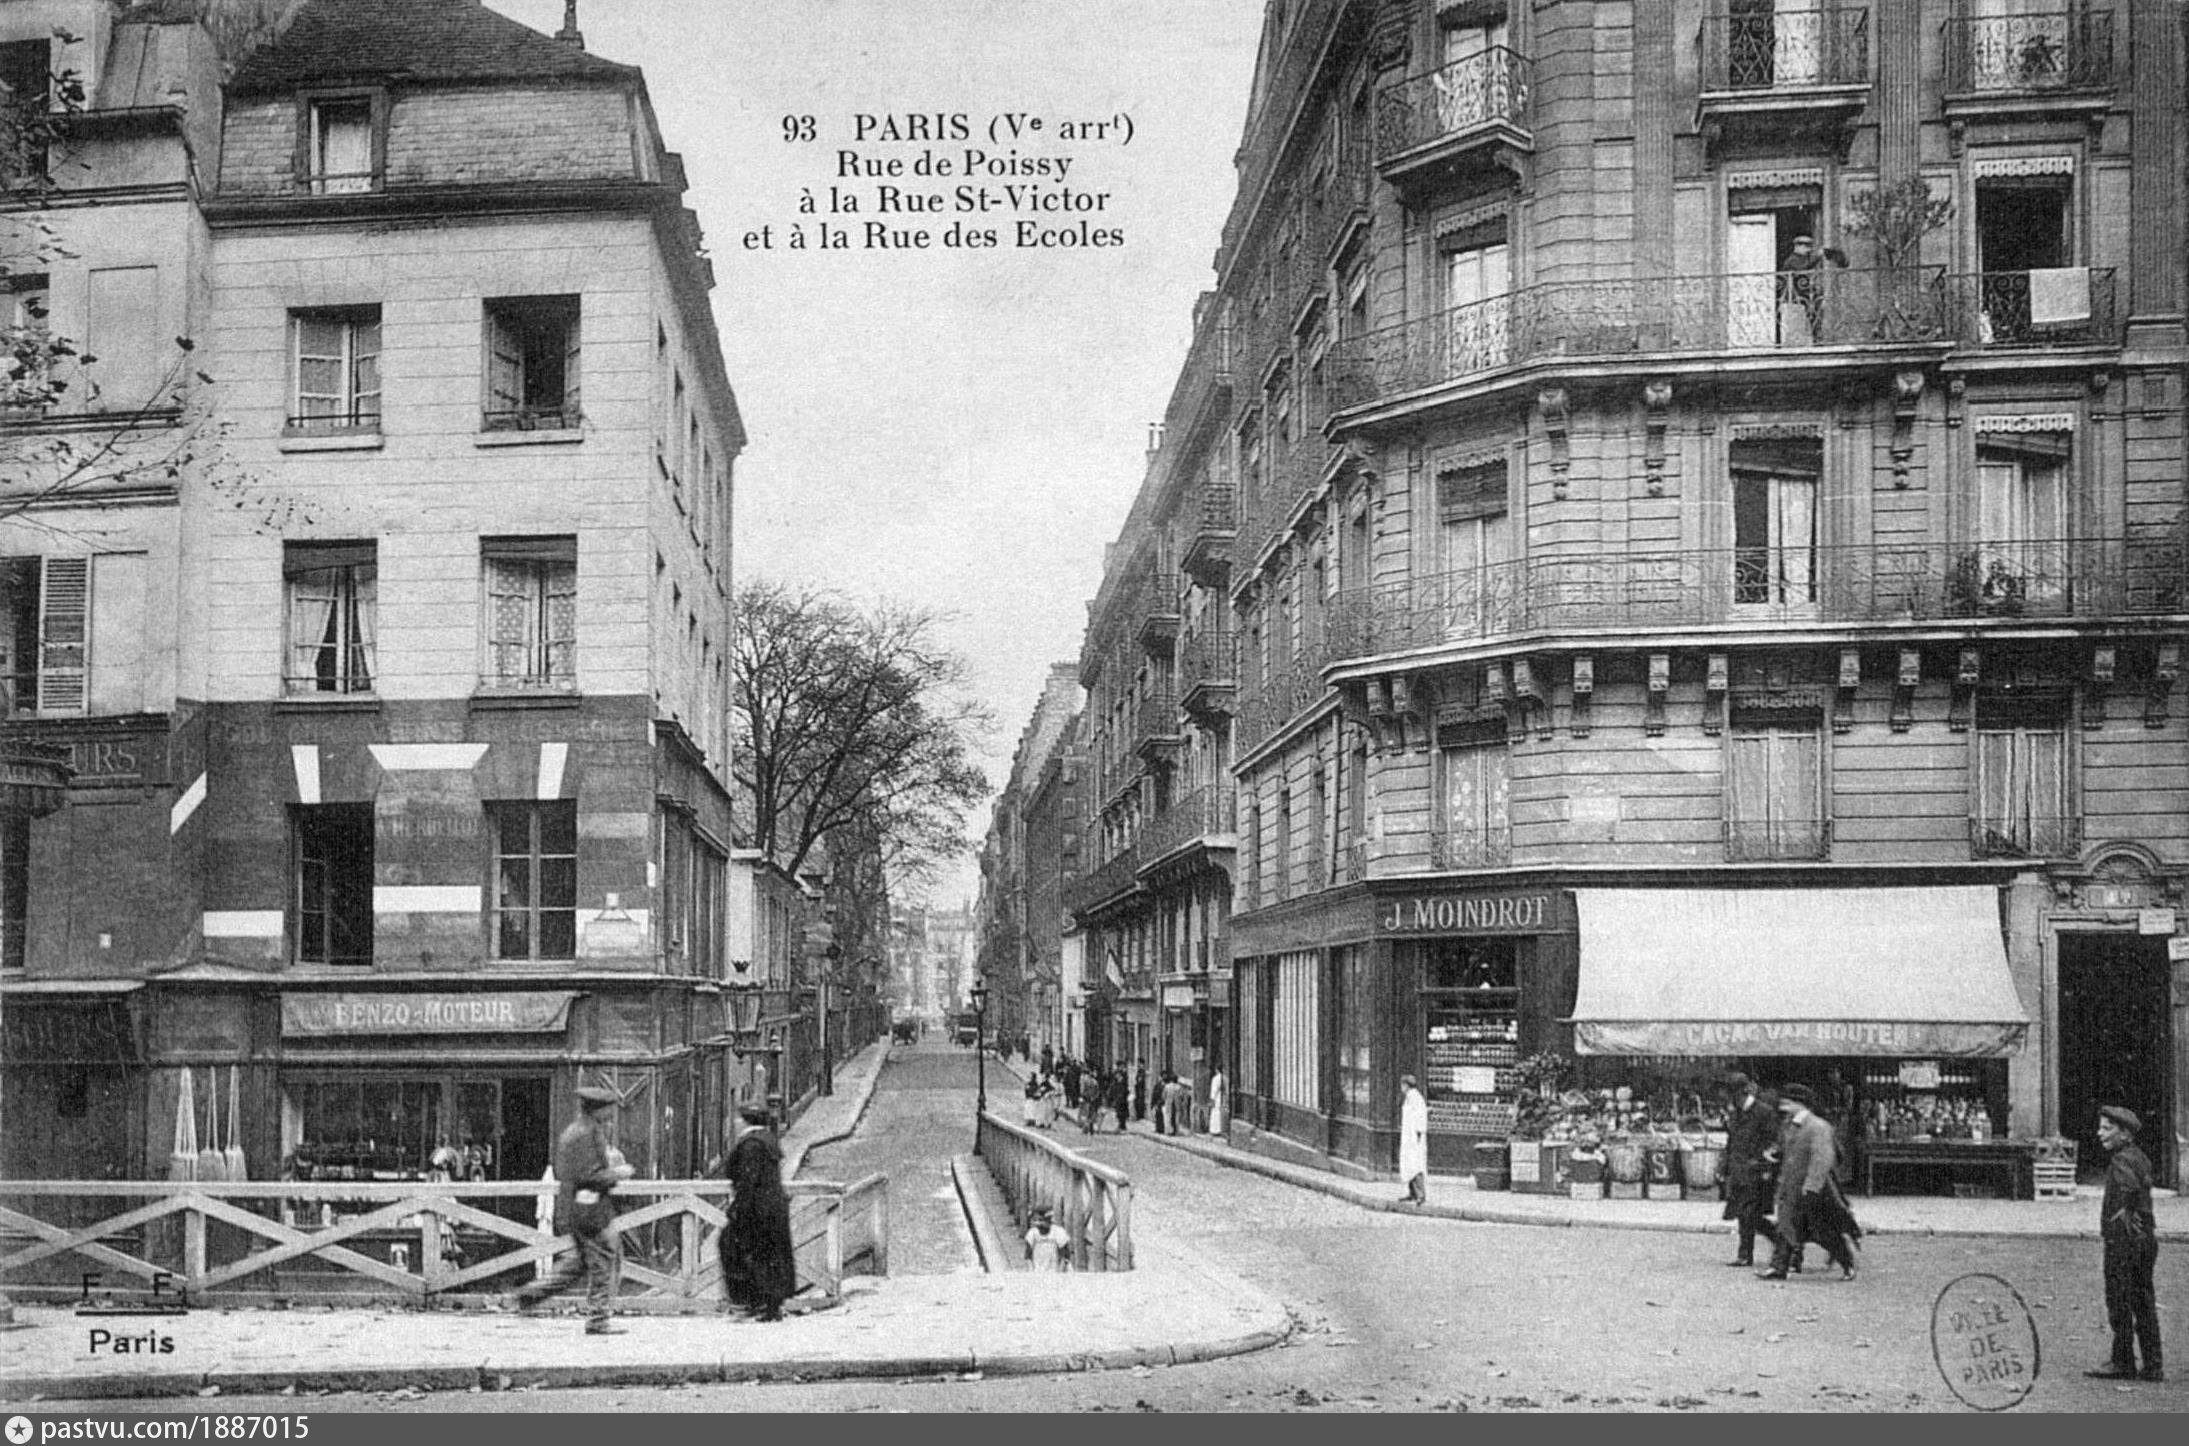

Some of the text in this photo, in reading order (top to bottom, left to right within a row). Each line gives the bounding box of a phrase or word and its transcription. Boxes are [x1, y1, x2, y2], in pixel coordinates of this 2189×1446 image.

[70, 742, 136, 773] URS
[1413, 895, 1549, 930] MOINDROT
[1816, 1022, 1909, 1046] HOUTEN
